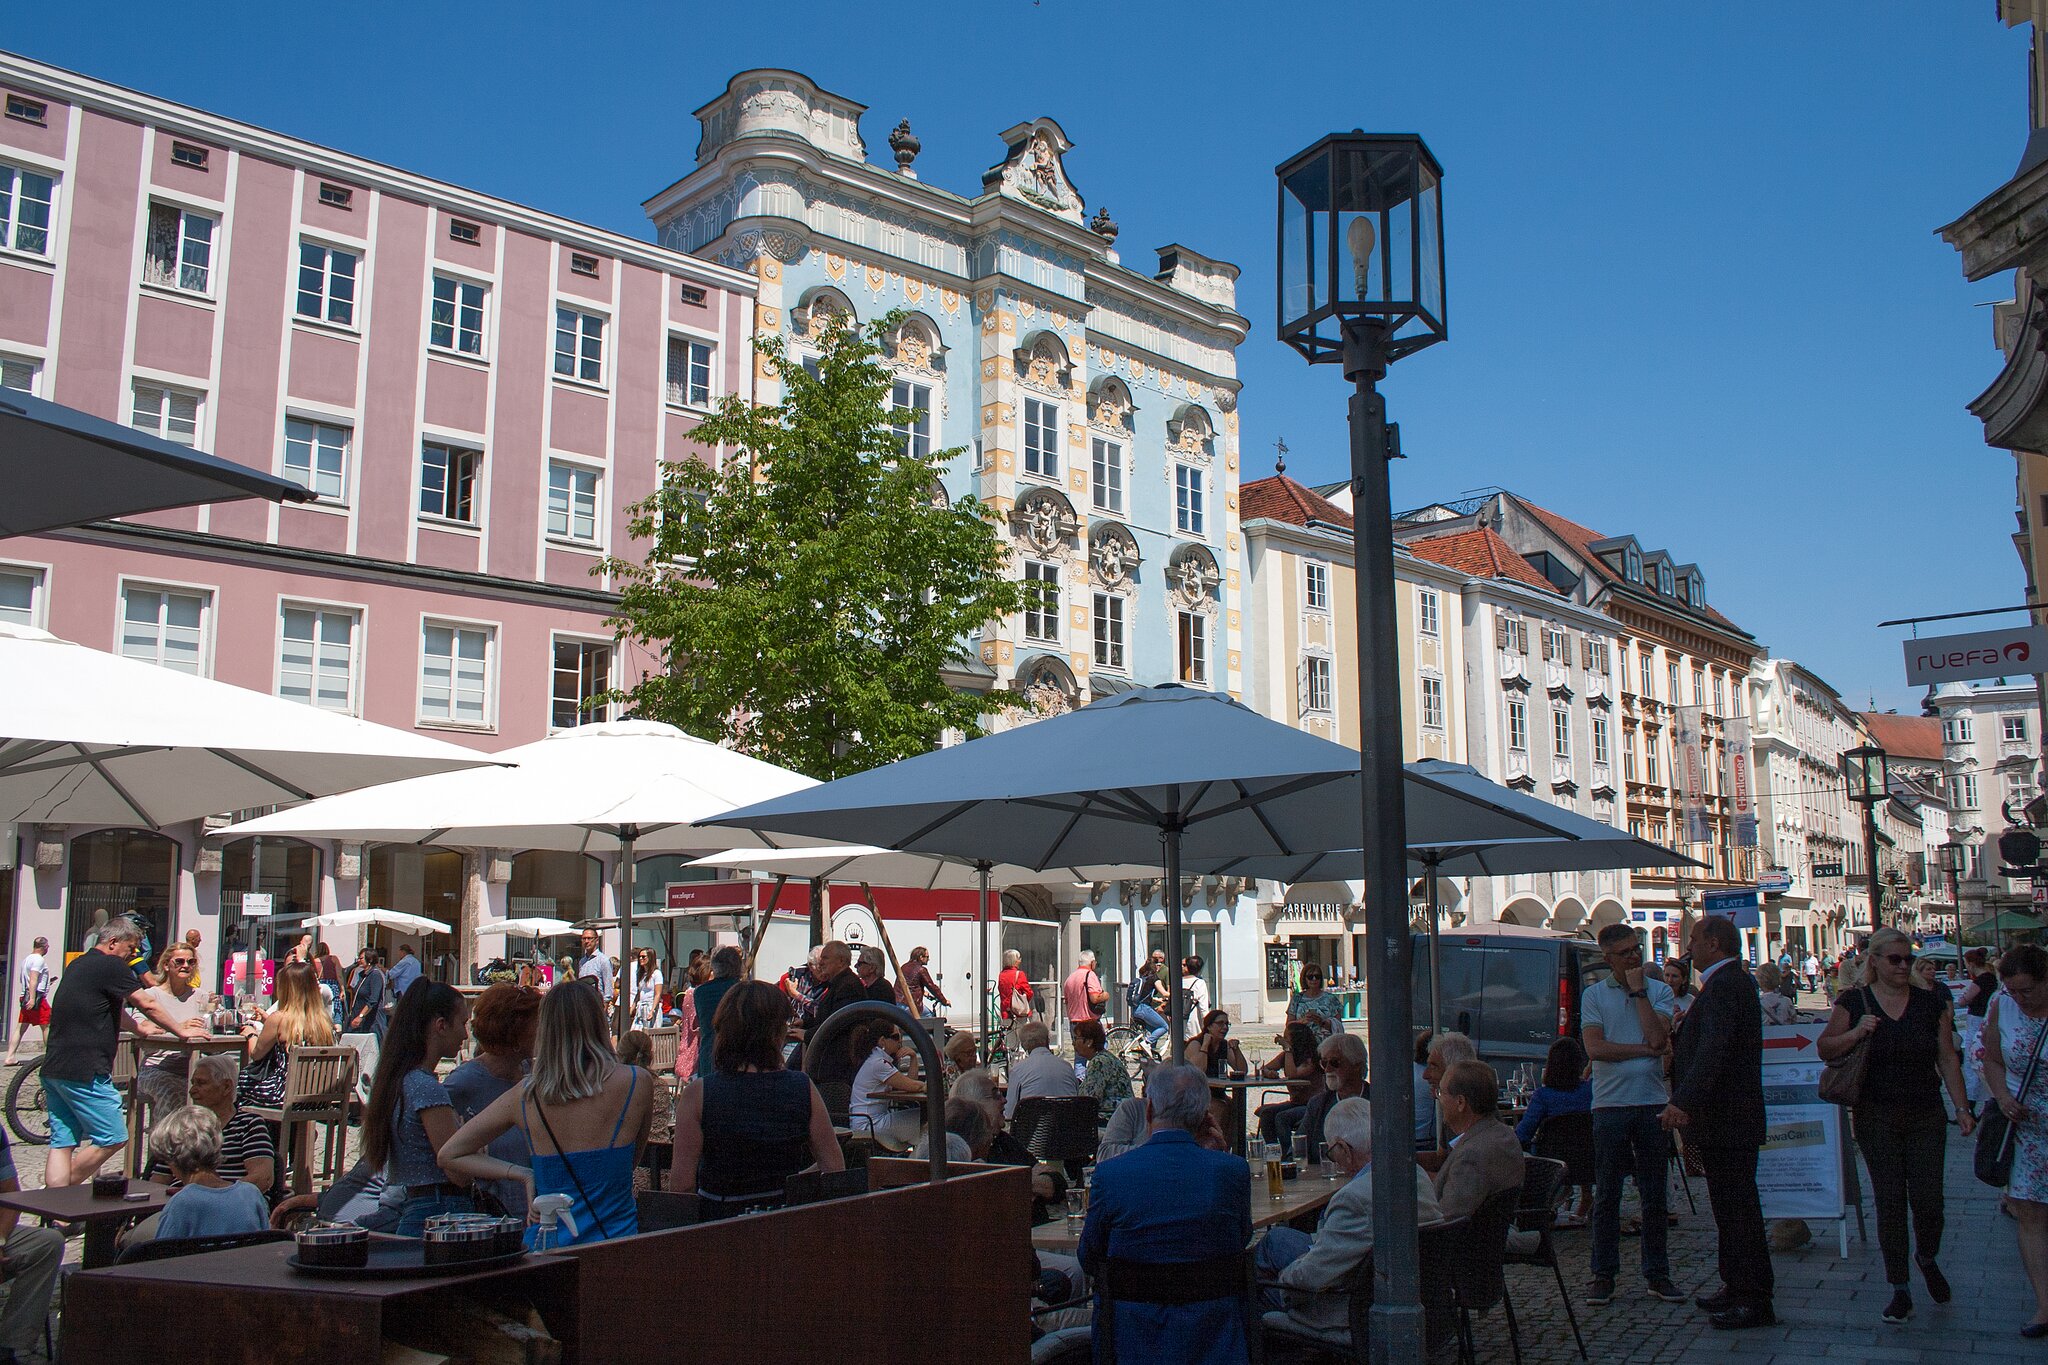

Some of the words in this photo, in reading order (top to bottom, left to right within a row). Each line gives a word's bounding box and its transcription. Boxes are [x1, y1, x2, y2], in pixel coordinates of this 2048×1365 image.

[1917, 648, 1999, 671] ruefa
[1815, 864, 1840, 875] oui
[1282, 903, 1341, 913] PARFUMERIE
[1716, 899, 1745, 908] PLATZ
[1727, 911, 1737, 922] 7
[1765, 1129, 1821, 1143] owaCanto
